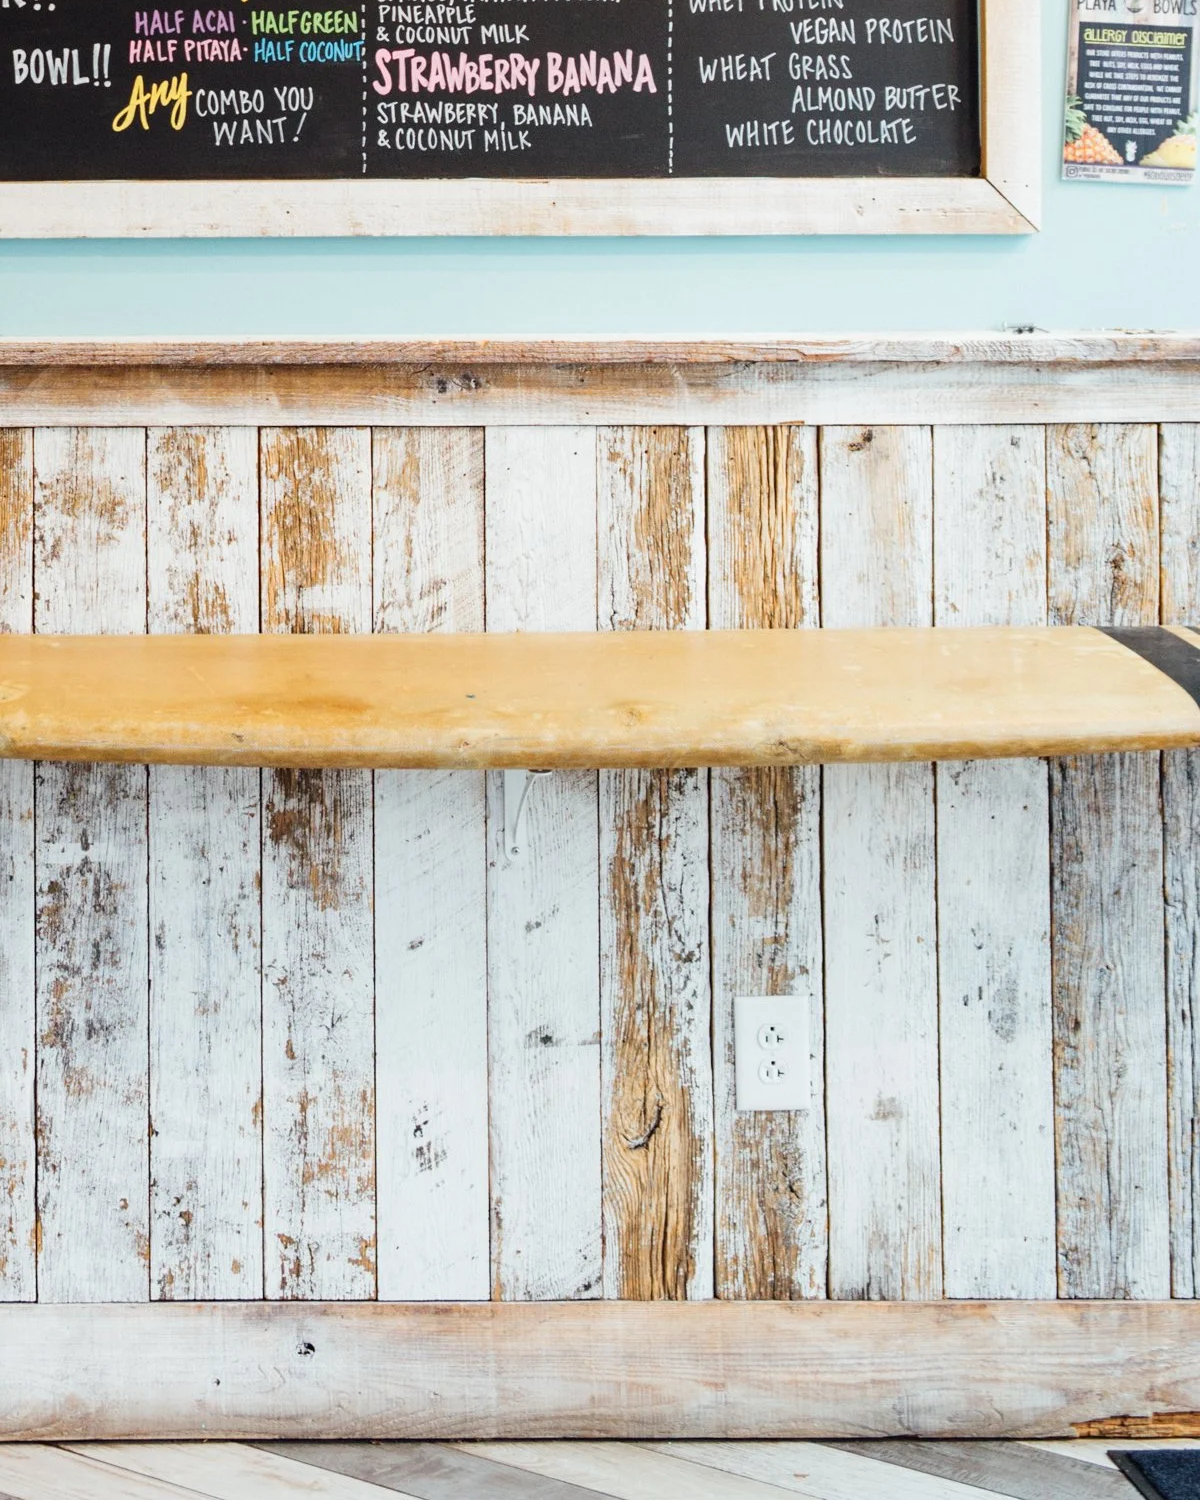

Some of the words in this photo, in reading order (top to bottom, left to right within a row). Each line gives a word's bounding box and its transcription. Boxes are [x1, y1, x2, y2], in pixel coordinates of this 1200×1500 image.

[12, 42, 112, 88] BOWL!!
[372, 47, 541, 97] STRAWBERRY
[546, 48, 658, 97] BANANA
[111, 72, 193, 133] Any
[195, 88, 265, 118] COMBO
[273, 85, 314, 112] YOU
[212, 111, 308, 147] WANT!
[725, 119, 795, 148] WHITE
[806, 117, 917, 147] CHOCOLATE
